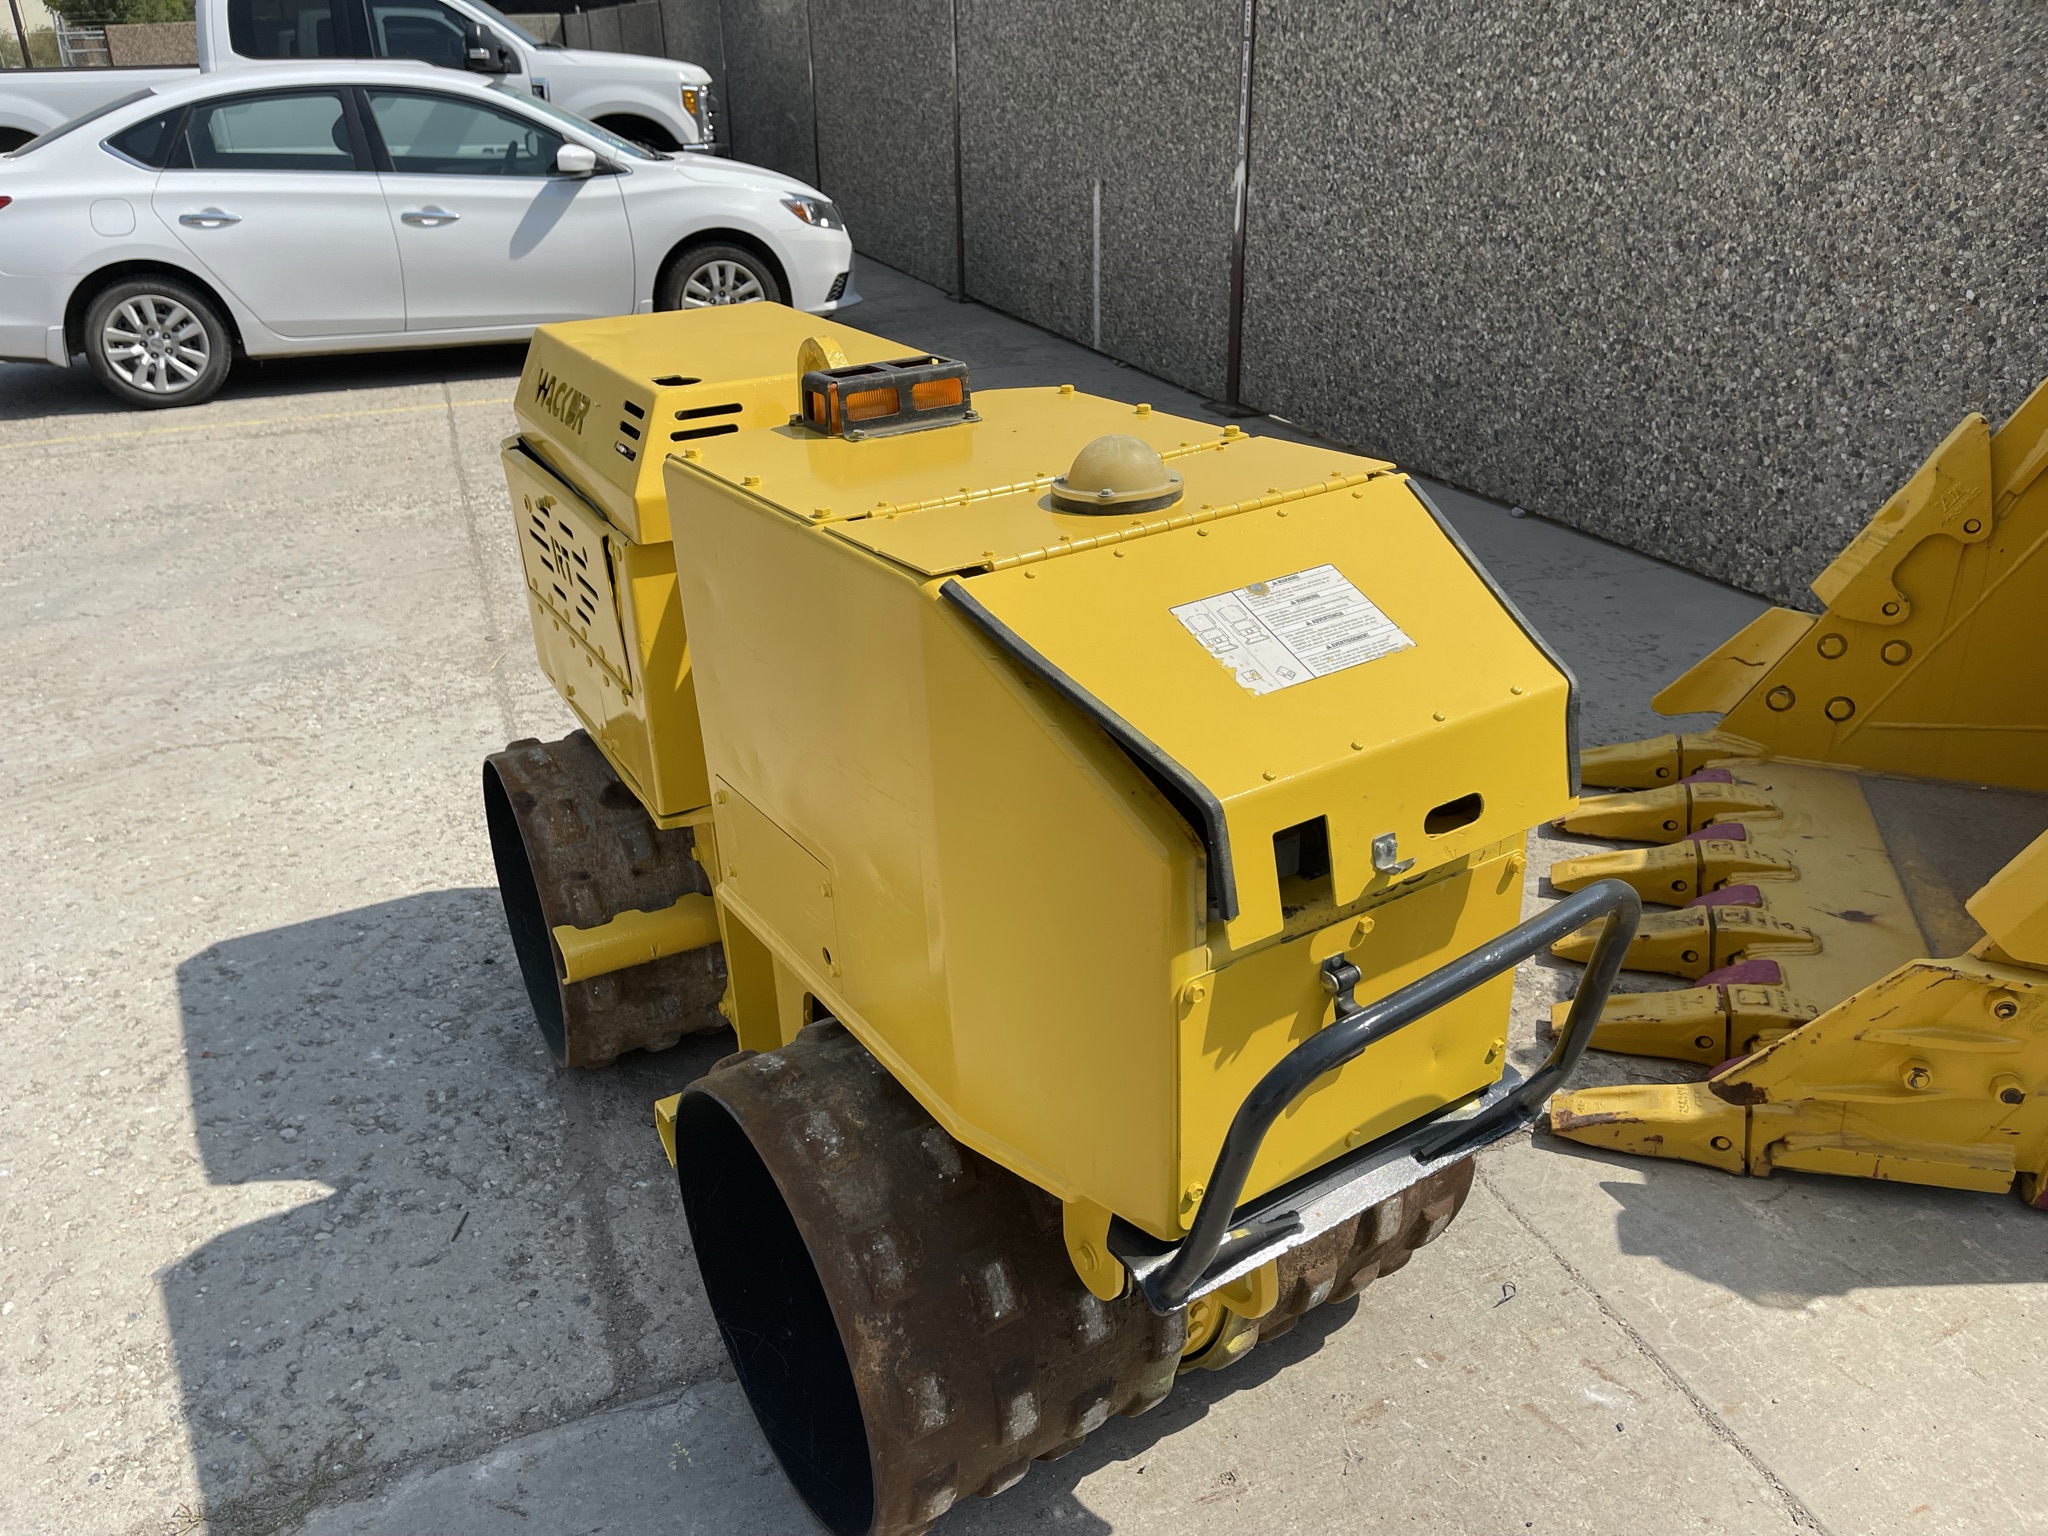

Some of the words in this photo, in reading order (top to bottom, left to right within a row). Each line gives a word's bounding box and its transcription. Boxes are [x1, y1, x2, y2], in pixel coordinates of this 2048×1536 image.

[1276, 574, 1300, 583] WARNING
[1294, 593, 1320, 603] WARNING
[1311, 611, 1344, 623] ADVERTENCIA
[1330, 632, 1370, 647] AVERTISSEMENT
